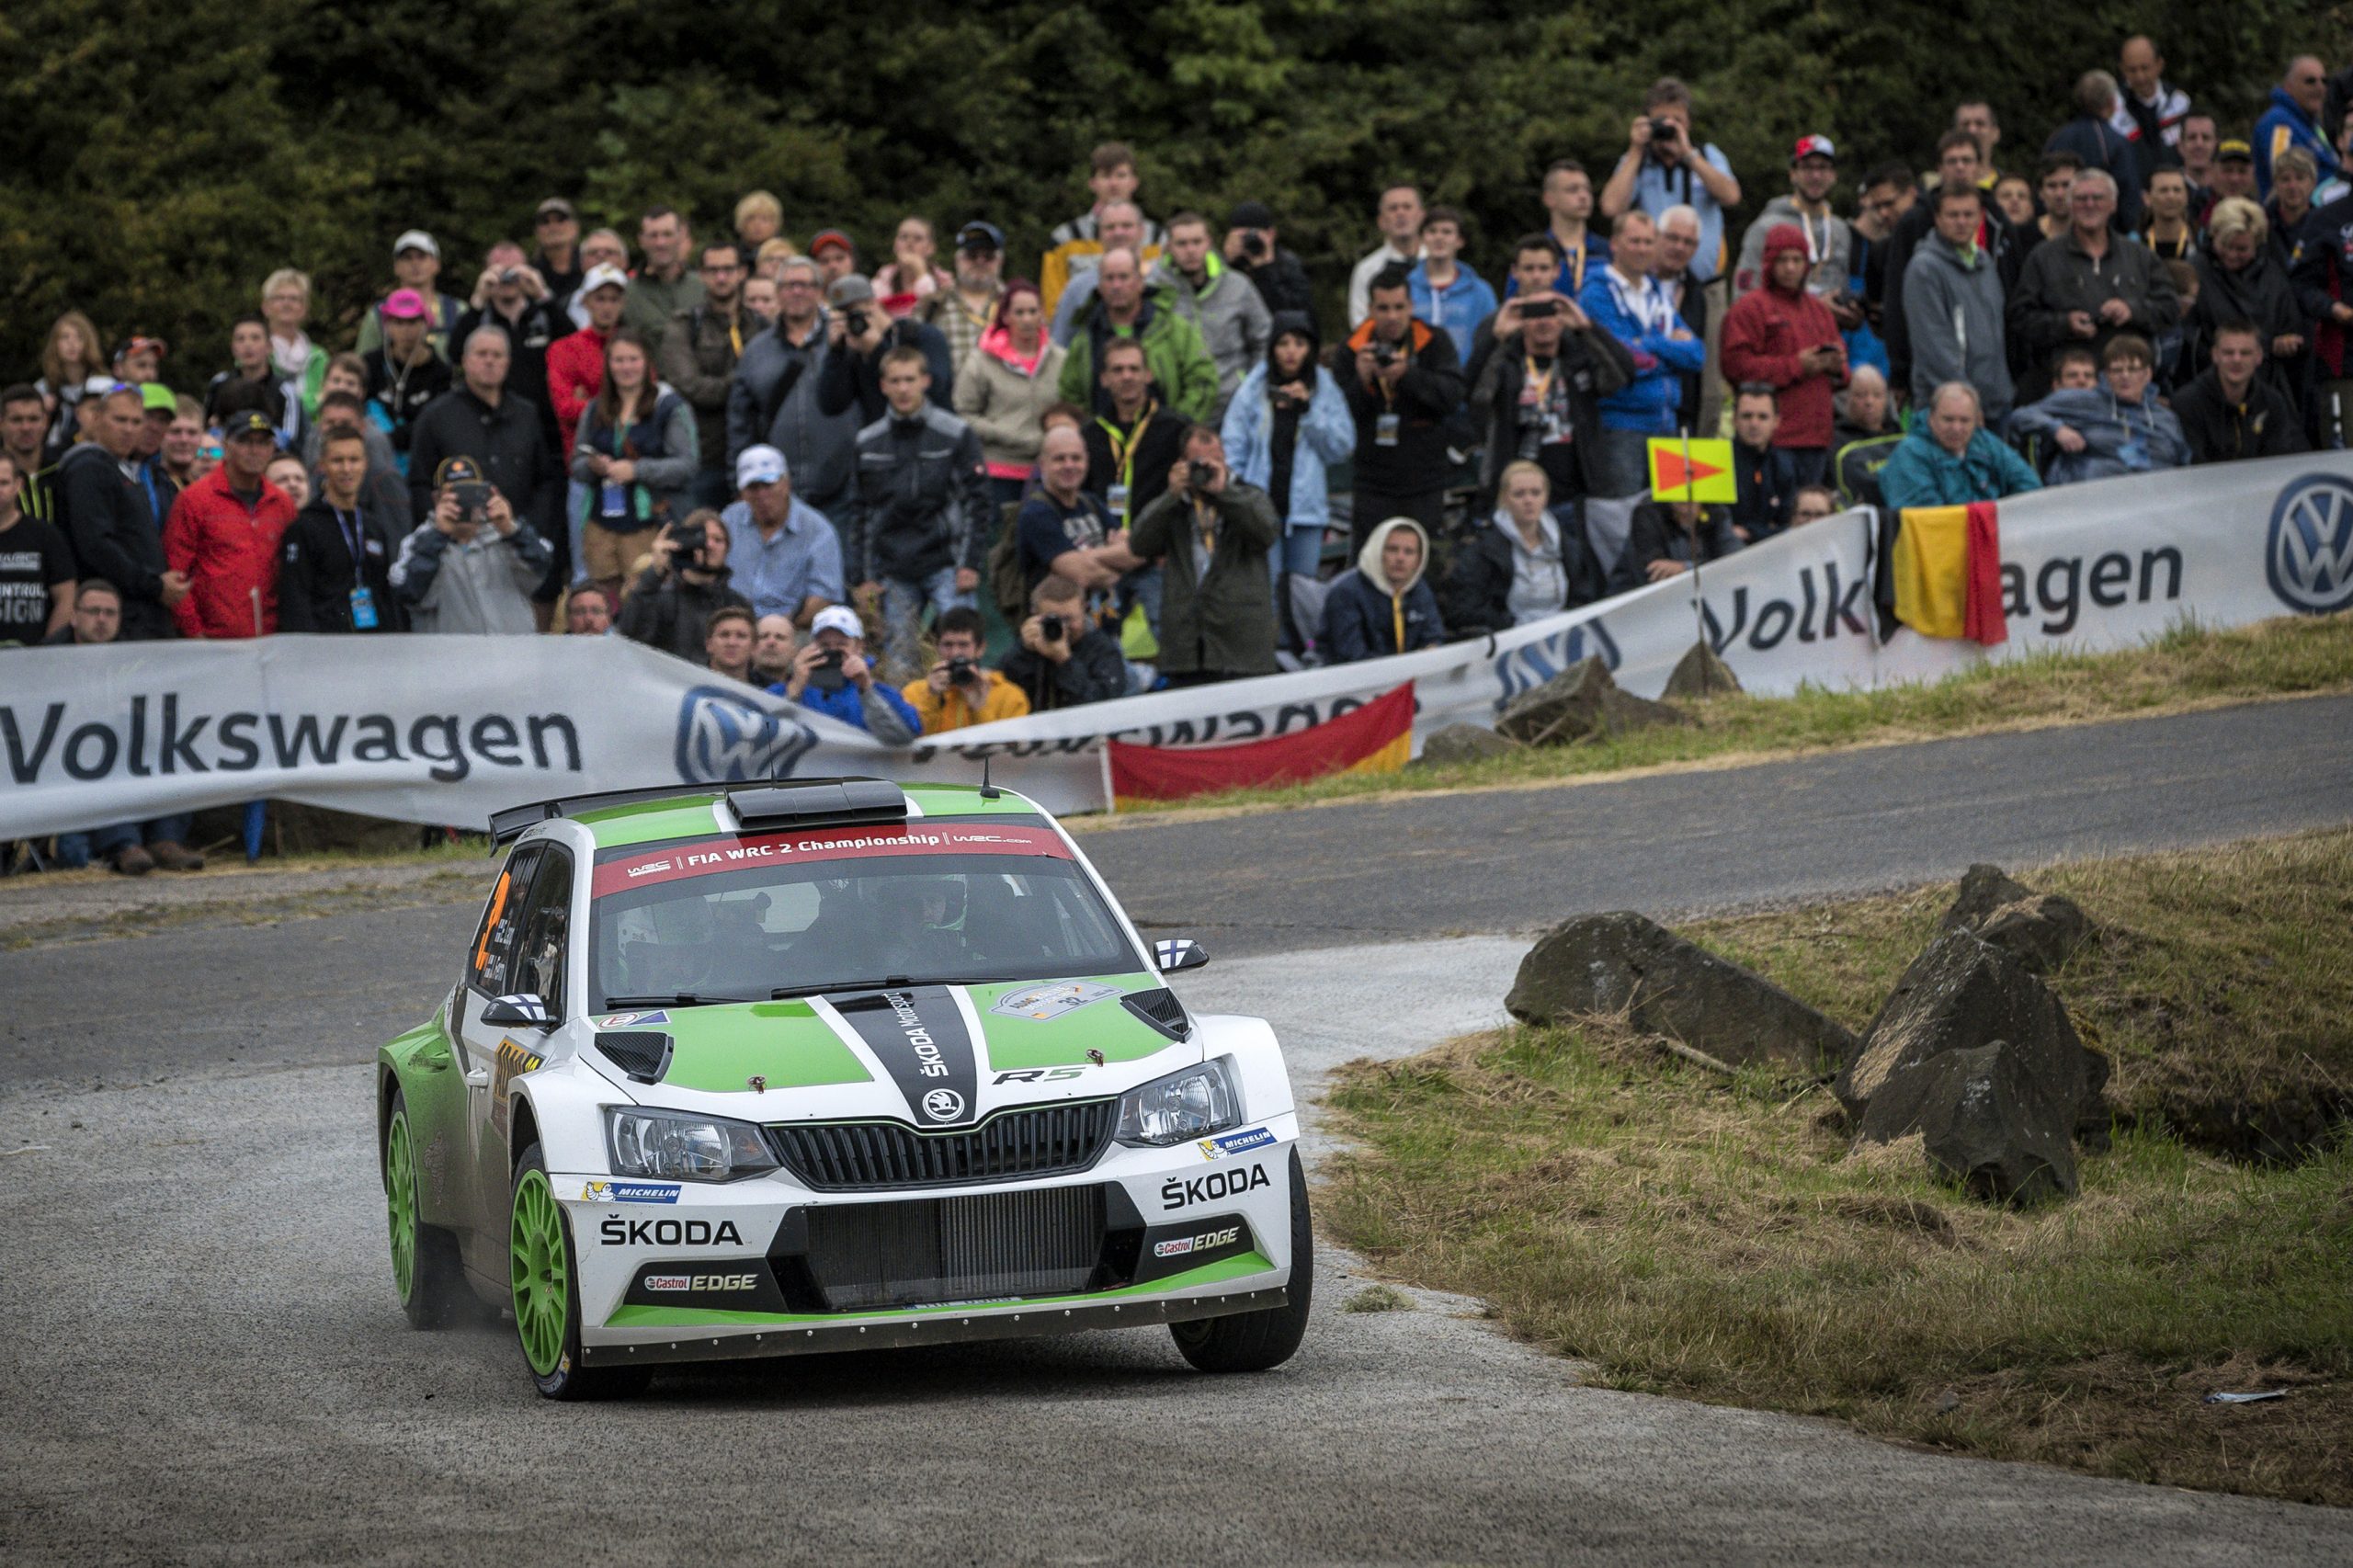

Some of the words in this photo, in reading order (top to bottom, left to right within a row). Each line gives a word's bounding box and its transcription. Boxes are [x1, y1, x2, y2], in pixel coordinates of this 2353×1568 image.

[1690, 545, 2184, 656] Volkagen
[0, 692, 583, 784] Volkswagen
[628, 860, 671, 873] WRC
[688, 854, 722, 867] FIA
[726, 846, 774, 860] WRC
[779, 844, 793, 854] 2
[798, 834, 940, 852] Championship
[904, 1027, 949, 1078] ŠKODA
[992, 1066, 1086, 1085] R5
[1225, 1131, 1271, 1149] MICHELIN
[618, 1187, 680, 1198] MICHELIN
[1161, 1163, 1271, 1210] ŠKODA
[600, 1213, 744, 1246] ŠKODA
[1164, 1241, 1191, 1255] Castrol
[1193, 1226, 1241, 1252] EDGE
[655, 1276, 688, 1290] Castrol
[690, 1274, 759, 1291] EDGE
